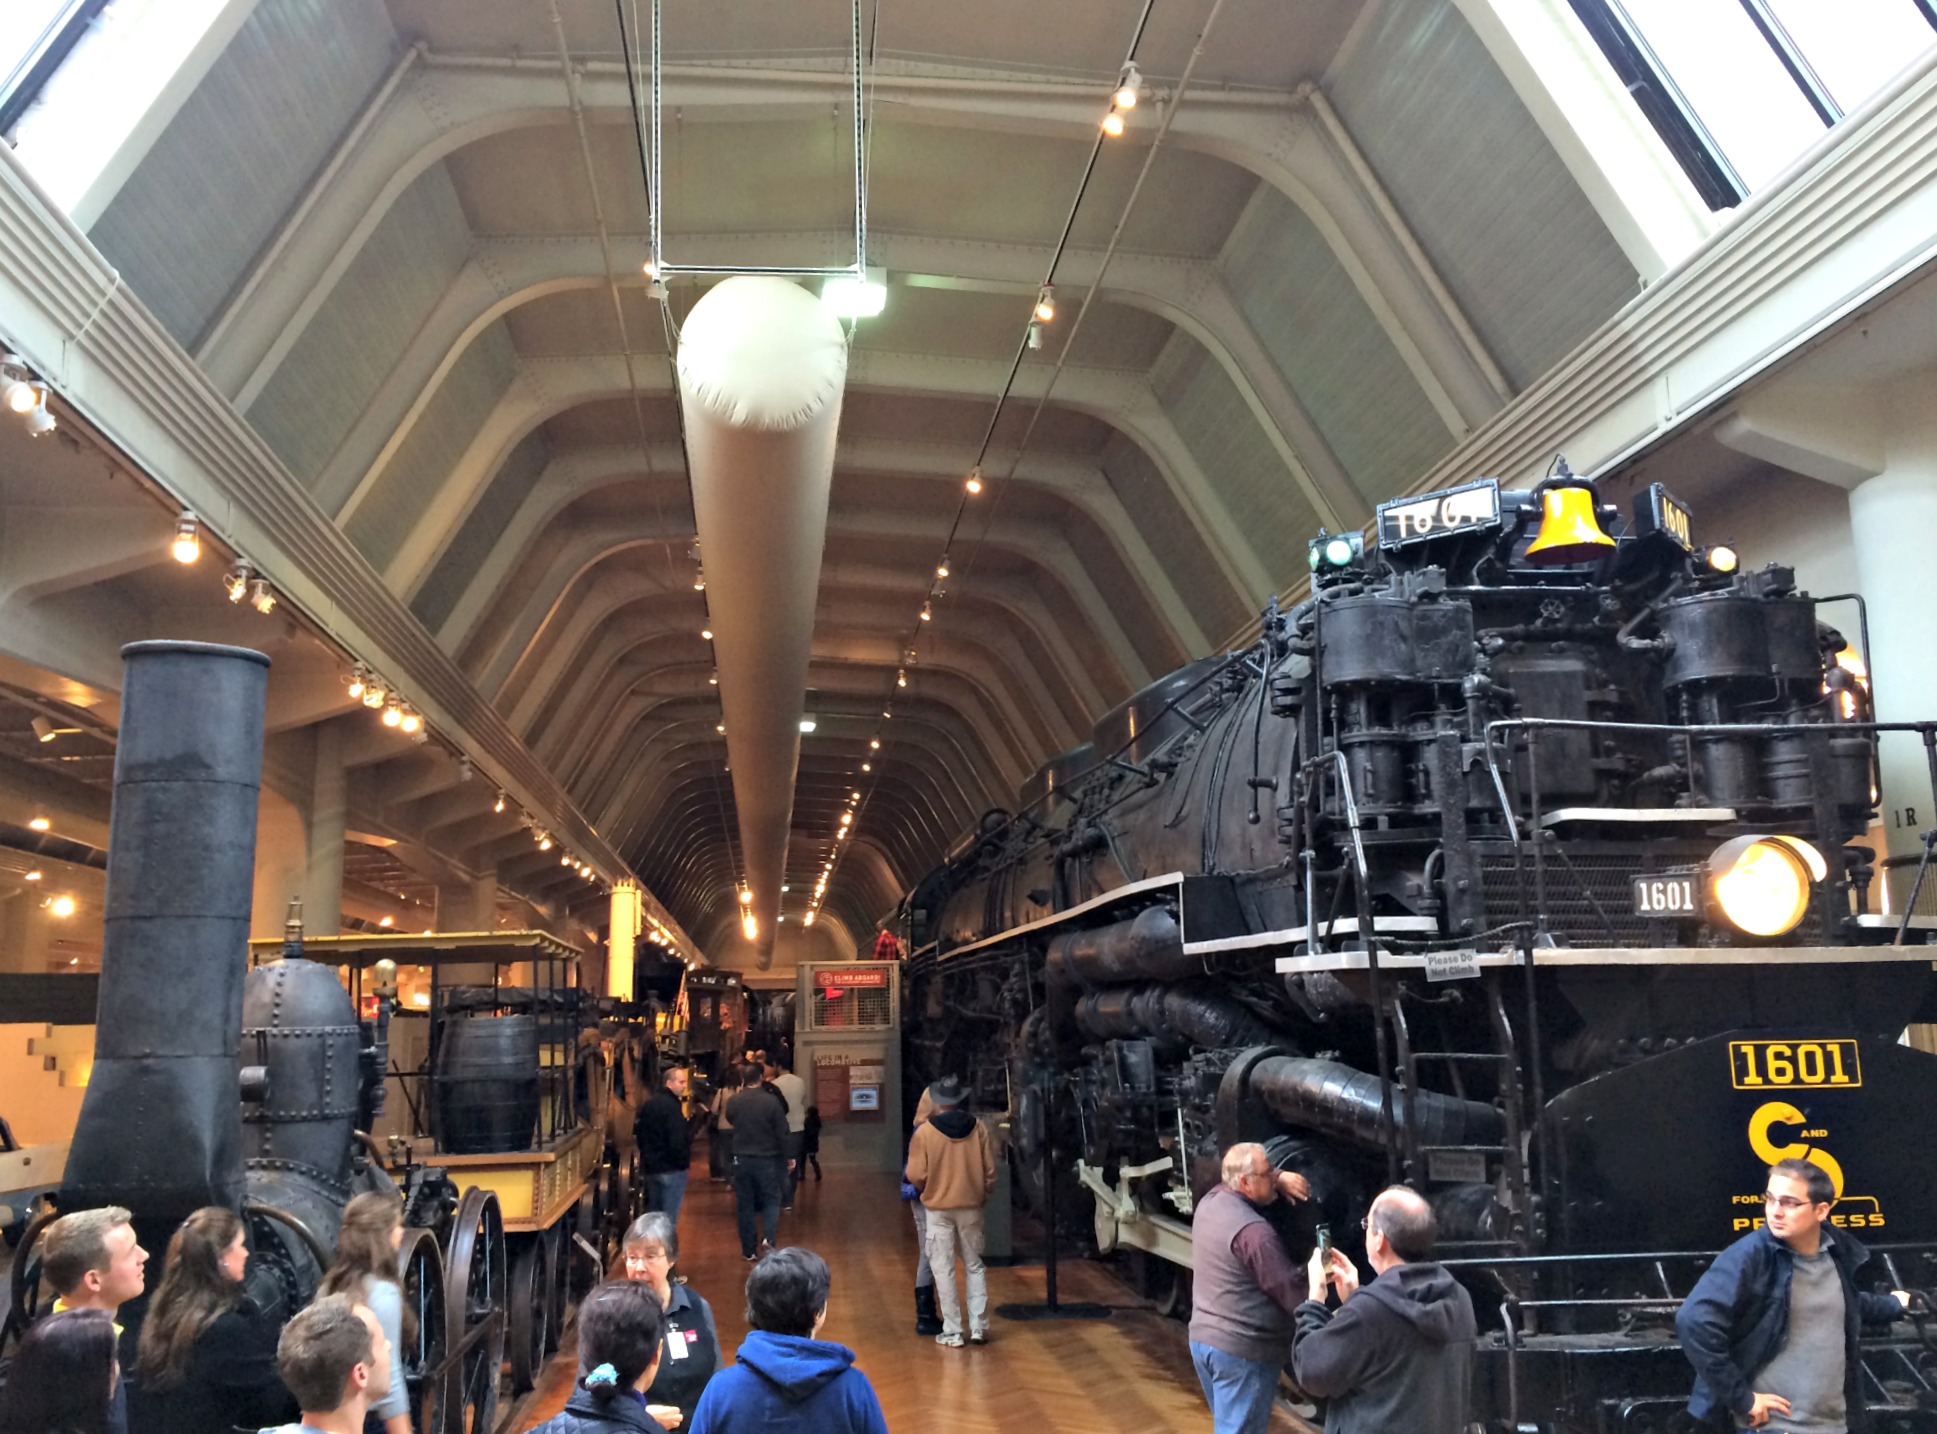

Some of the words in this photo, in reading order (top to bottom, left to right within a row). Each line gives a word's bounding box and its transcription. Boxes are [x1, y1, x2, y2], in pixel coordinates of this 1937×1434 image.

[1663, 496, 1689, 545] 1601
[1905, 807, 1917, 827] R
[1639, 881, 1694, 911] 1601
[1428, 955, 1459, 966] Please
[1460, 953, 1473, 963] Do
[1431, 967, 1447, 977] Not
[1740, 1044, 1849, 1084] 1601
[1800, 1129, 1829, 1138] AND
[1732, 1194, 1764, 1204] FOR
